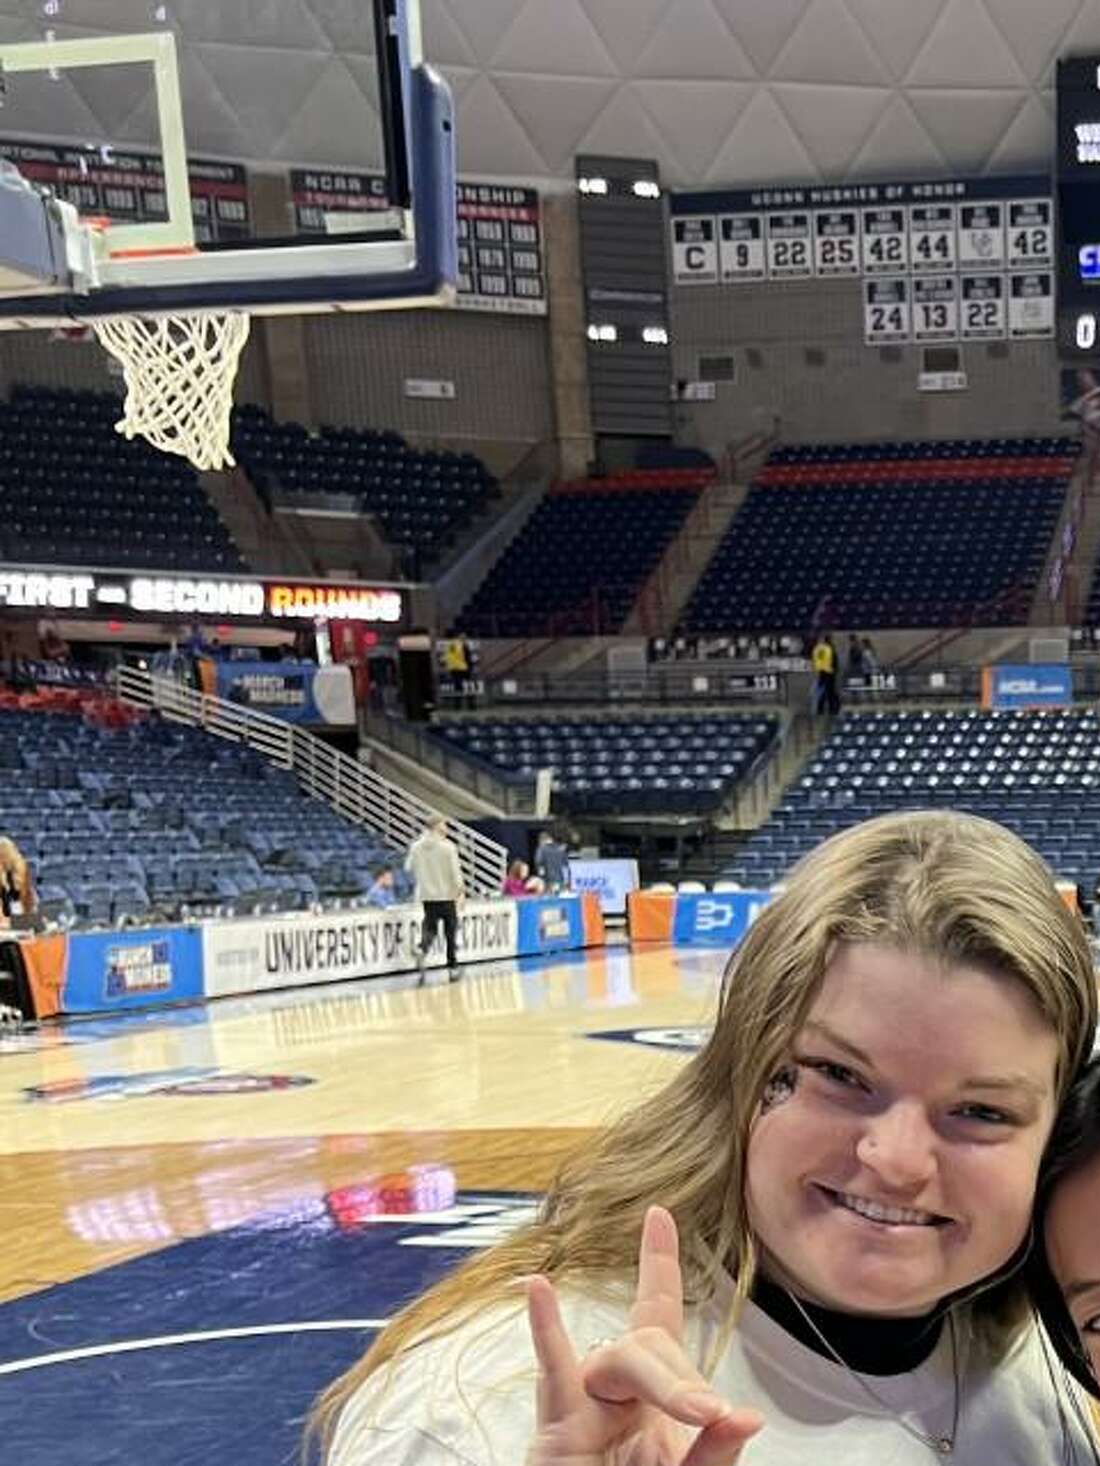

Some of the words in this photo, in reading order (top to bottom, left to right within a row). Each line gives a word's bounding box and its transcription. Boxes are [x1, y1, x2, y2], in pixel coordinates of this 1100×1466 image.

[773, 242, 806, 266] 22
[821, 240, 854, 263] 25
[869, 237, 902, 261] 42
[916, 235, 949, 259] 44
[1013, 230, 1047, 254] 42
[685, 247, 704, 269] C
[736, 244, 748, 267] 9
[871, 307, 902, 331] 24
[922, 305, 948, 328] 13
[967, 303, 997, 326] 22
[1076, 314, 1096, 349] 0
[131, 577, 265, 617] SECOND
[270, 586, 402, 622] ROUNDS
[265, 920, 380, 972] UNIVERSITY
[384, 921, 403, 959] OF
